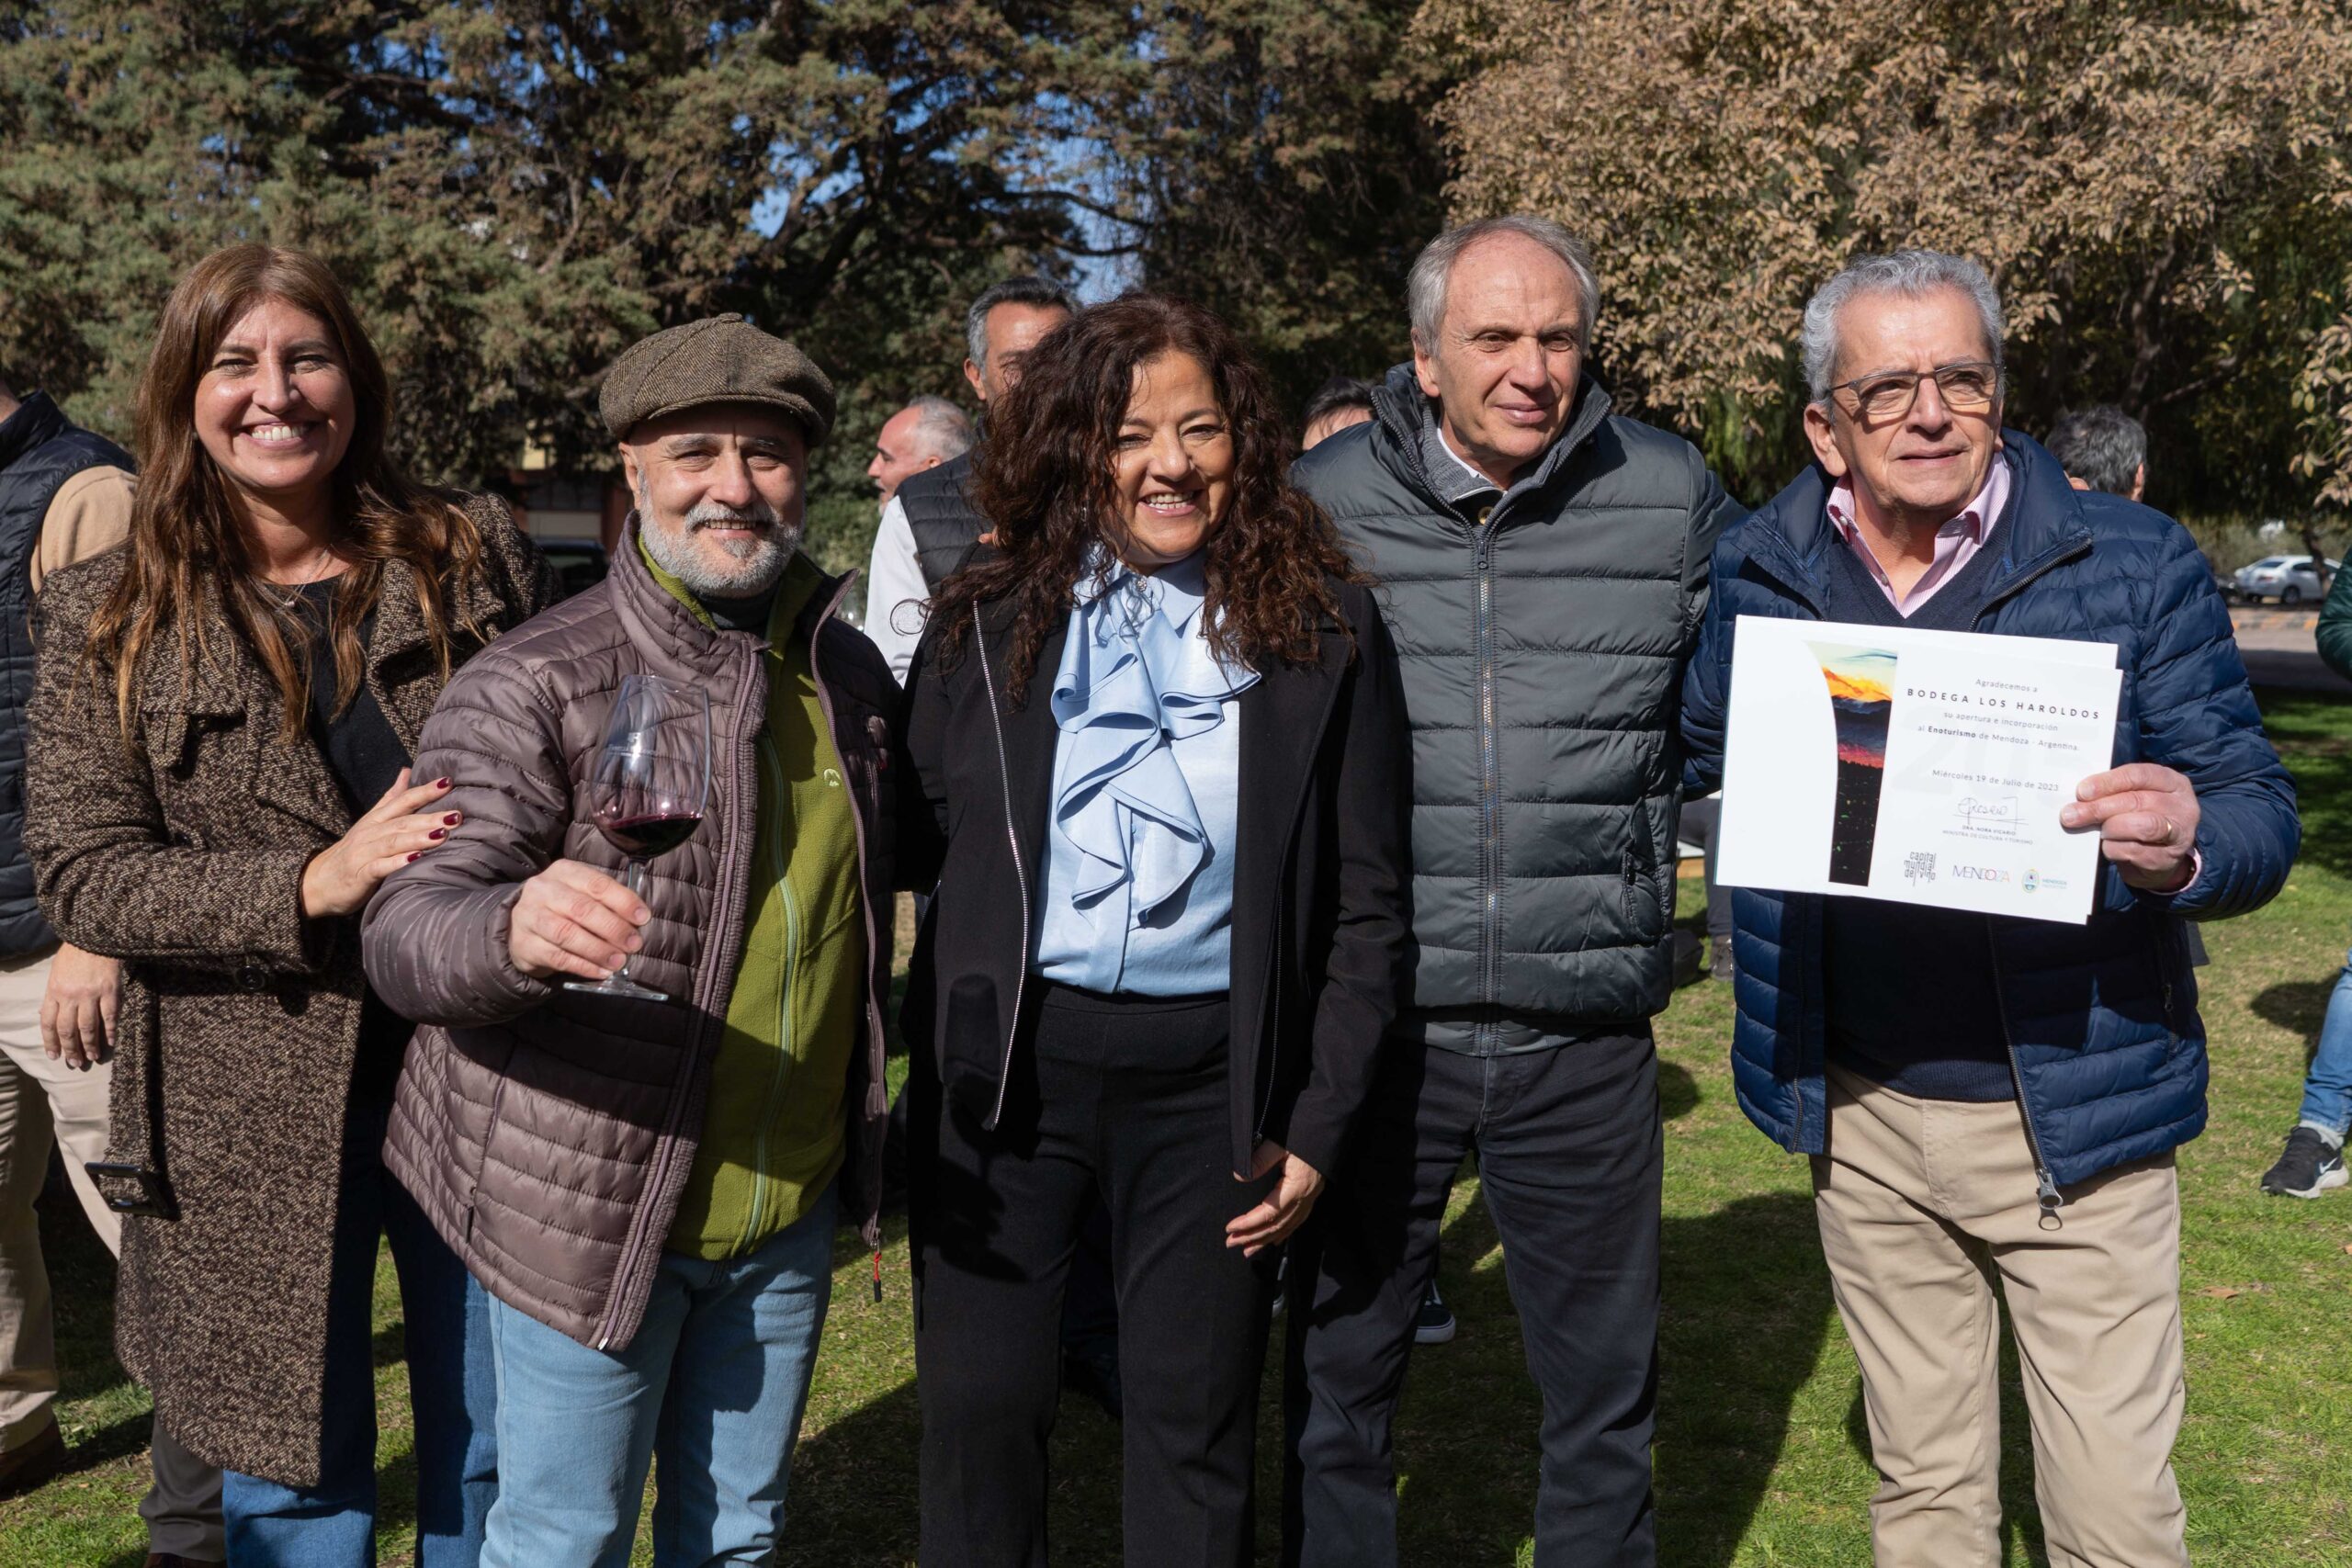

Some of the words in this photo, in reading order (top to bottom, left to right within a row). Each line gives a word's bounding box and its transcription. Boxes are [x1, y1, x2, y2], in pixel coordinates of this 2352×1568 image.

[1975, 679, 2030, 692] Agradecemos
[1907, 688, 1969, 704] BODEGA
[1980, 697, 2007, 708] LOS
[2017, 702, 2100, 719] HAROLDOS
[1956, 713, 1991, 724] apertura
[2001, 718, 2058, 731] incorporación
[1917, 724, 1926, 732] al
[1928, 726, 1976, 739] Enoturismo
[1978, 731, 1989, 739] de
[1992, 733, 2030, 745] Mendoza
[1932, 769, 1973, 781] Miércoles
[1976, 774, 1986, 783] 19
[1989, 775, 2000, 784] de
[2002, 777, 2022, 787] Julio
[2024, 780, 2035, 789] de
[2038, 782, 2059, 792] 2023
[1952, 865, 2010, 882] MENDOZA
